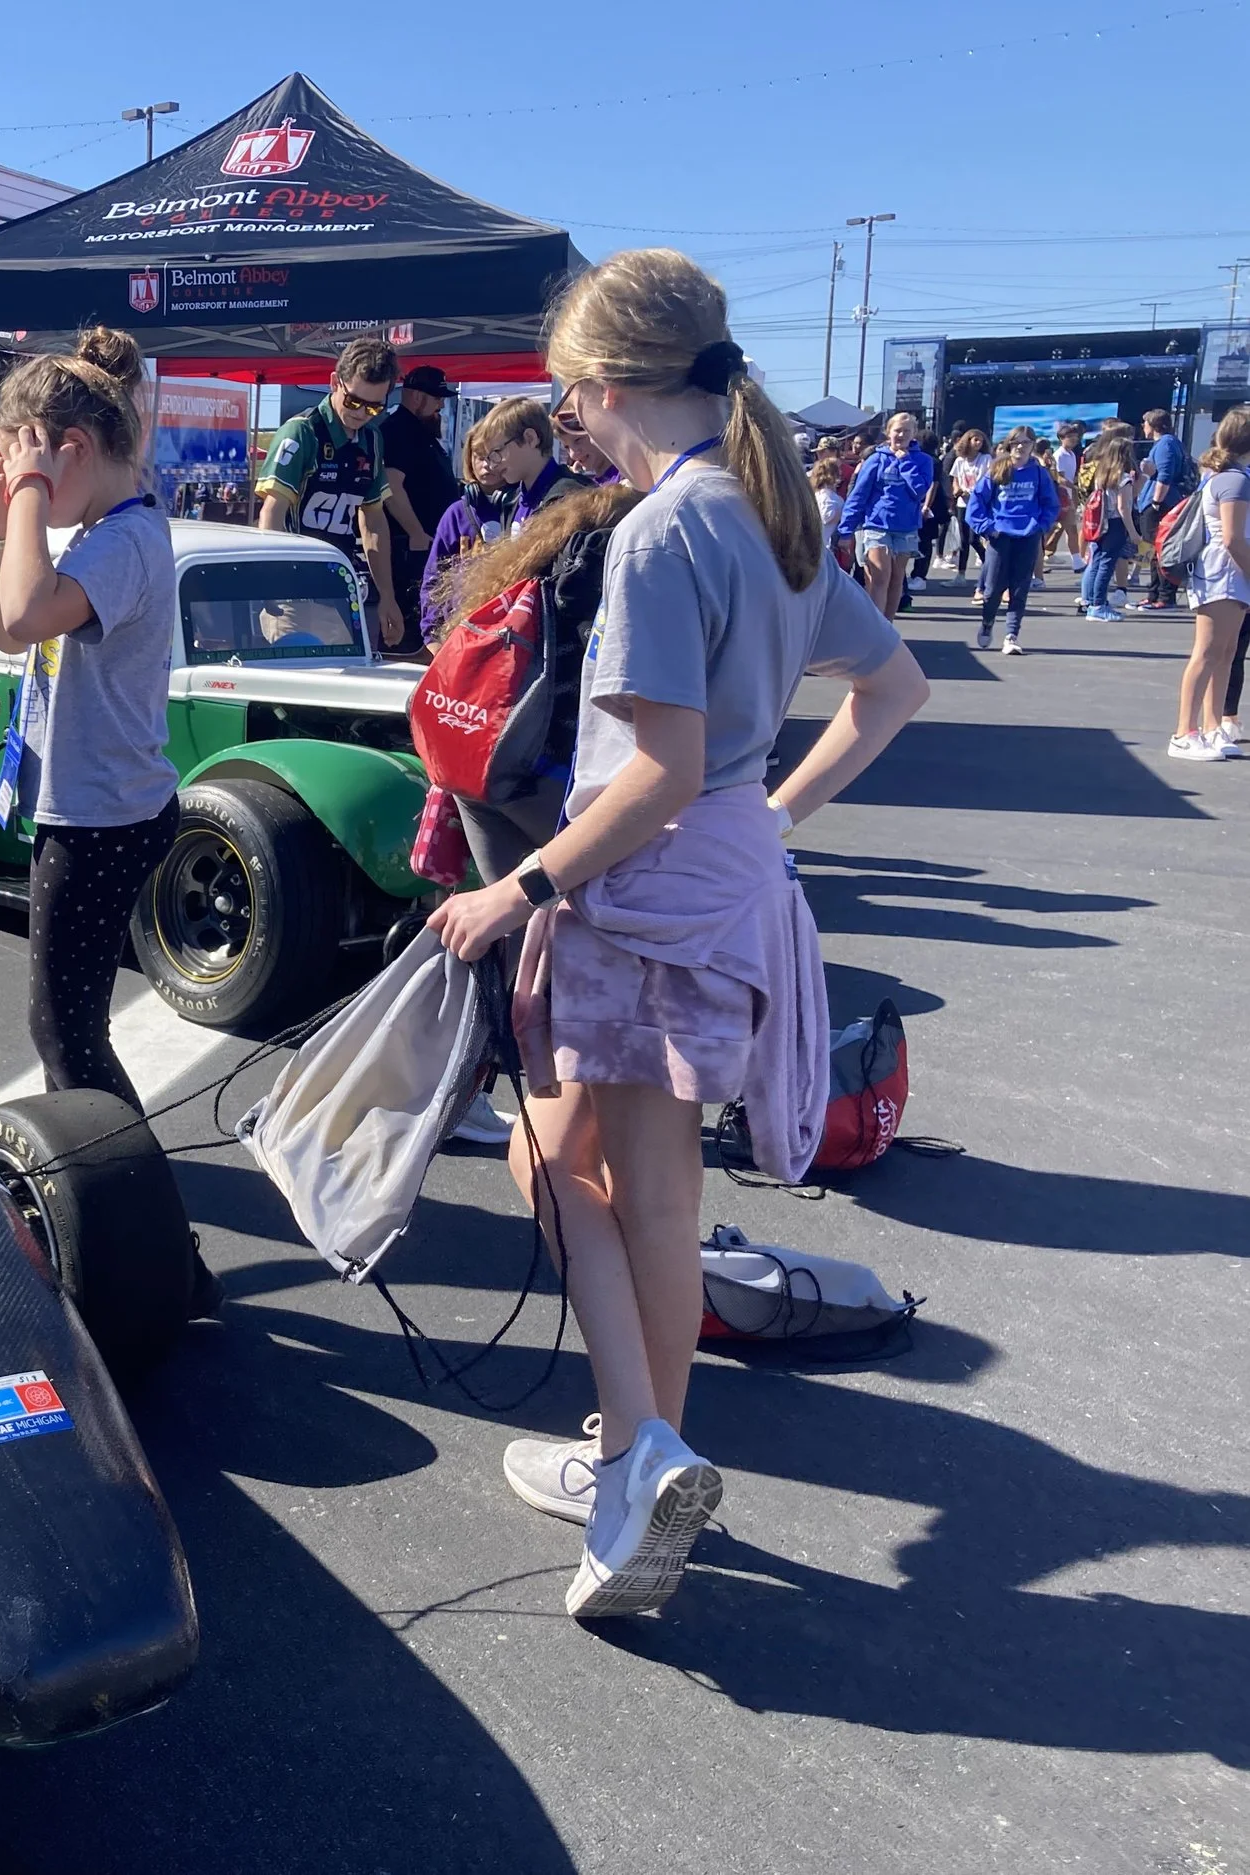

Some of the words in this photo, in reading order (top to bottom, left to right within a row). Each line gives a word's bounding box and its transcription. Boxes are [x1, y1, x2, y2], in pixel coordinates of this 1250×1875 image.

[102, 188, 260, 221] Belmont
[264, 187, 390, 212] Abbey
[84, 224, 221, 243] MOTORSPORT
[223, 222, 375, 233] MANAGEMENT
[171, 269, 237, 287] Belmont
[239, 266, 290, 285] Abbey
[171, 301, 227, 311] MOTORSPORT
[229, 299, 290, 310] MANAGEMENT
[425, 690, 488, 724] TOYOTA
[438, 713, 485, 735] Racing
[15, 1415, 64, 1431] MICHIGAN
